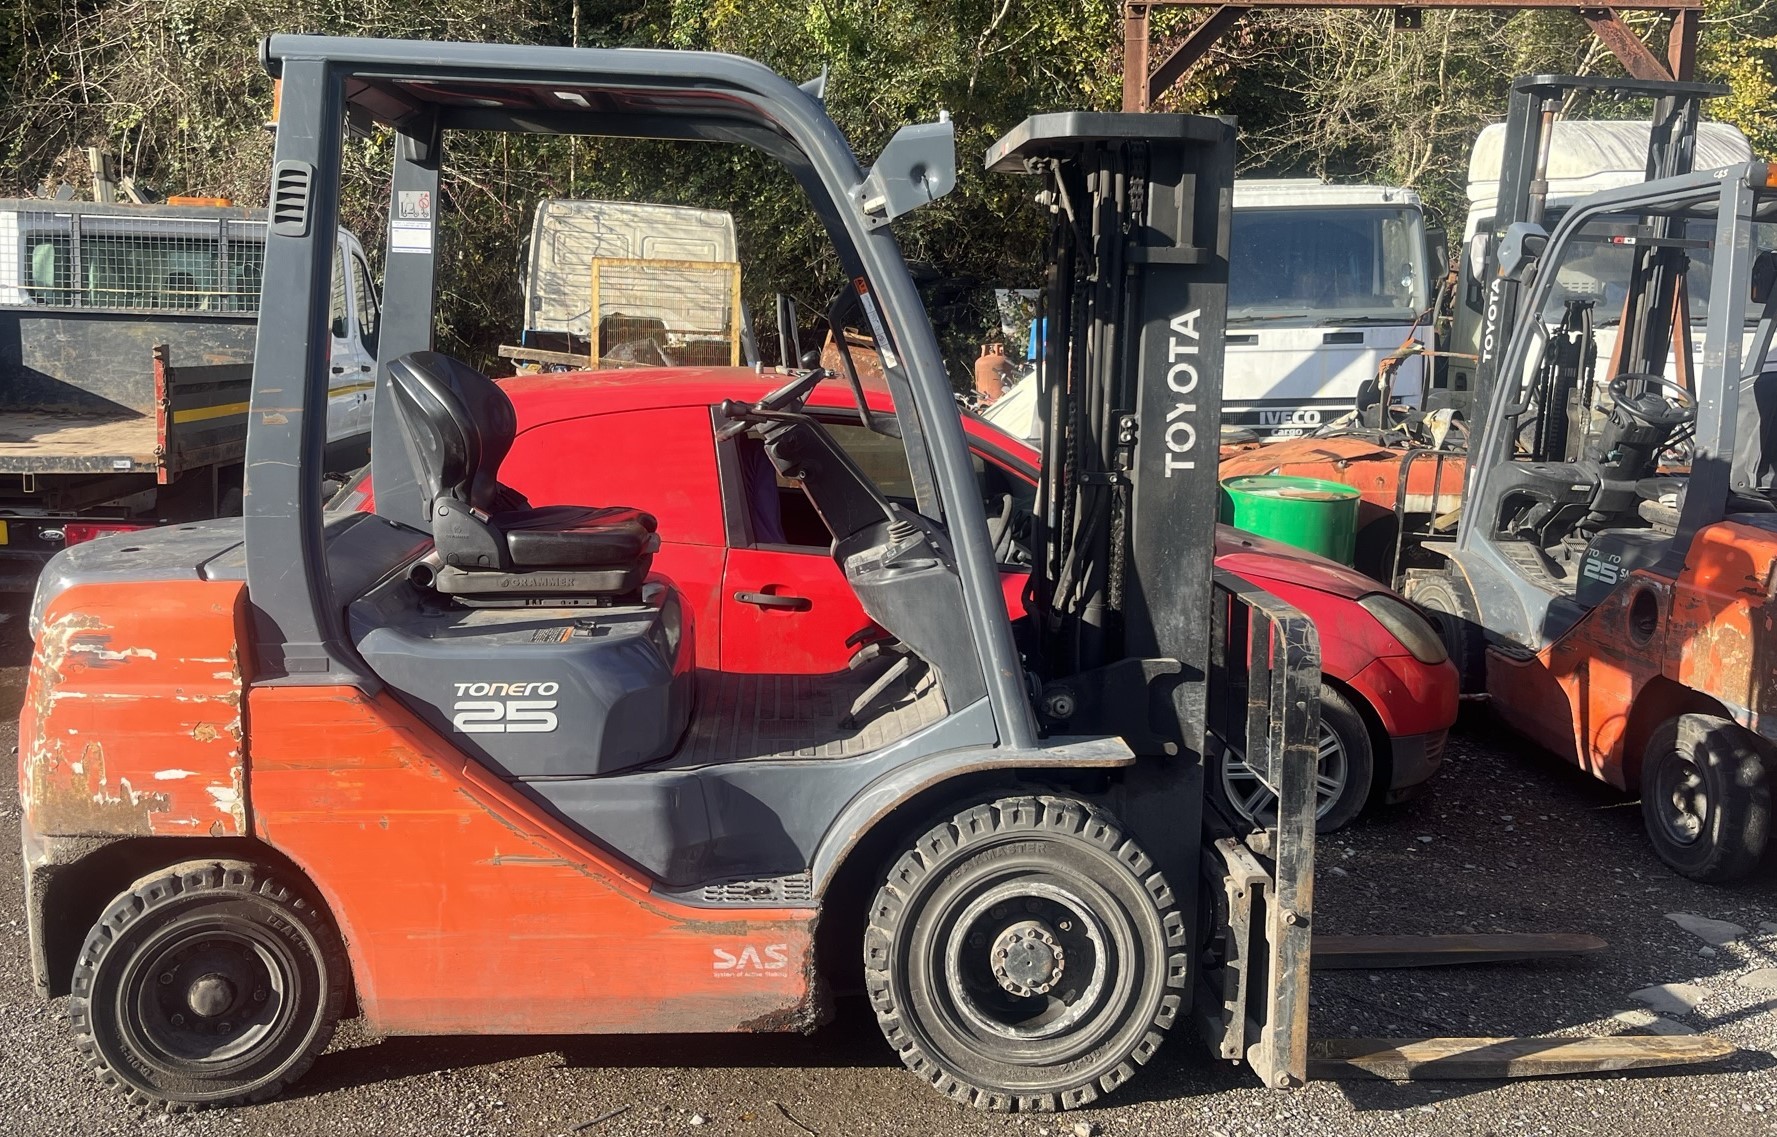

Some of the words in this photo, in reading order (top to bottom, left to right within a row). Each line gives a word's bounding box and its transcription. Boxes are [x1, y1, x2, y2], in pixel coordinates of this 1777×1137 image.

[1482, 278, 1501, 363] TOYOTA
[1164, 308, 1201, 478] TOYOTA
[1259, 410, 1321, 425] IVECO
[1270, 428, 1304, 437] Cargo
[511, 577, 576, 587] GRAMMER
[1583, 557, 1619, 585] 25
[453, 682, 559, 697] TONERO
[453, 700, 559, 733] 25
[943, 841, 1047, 885] PEAKMASTER
[712, 943, 788, 970] SAS
